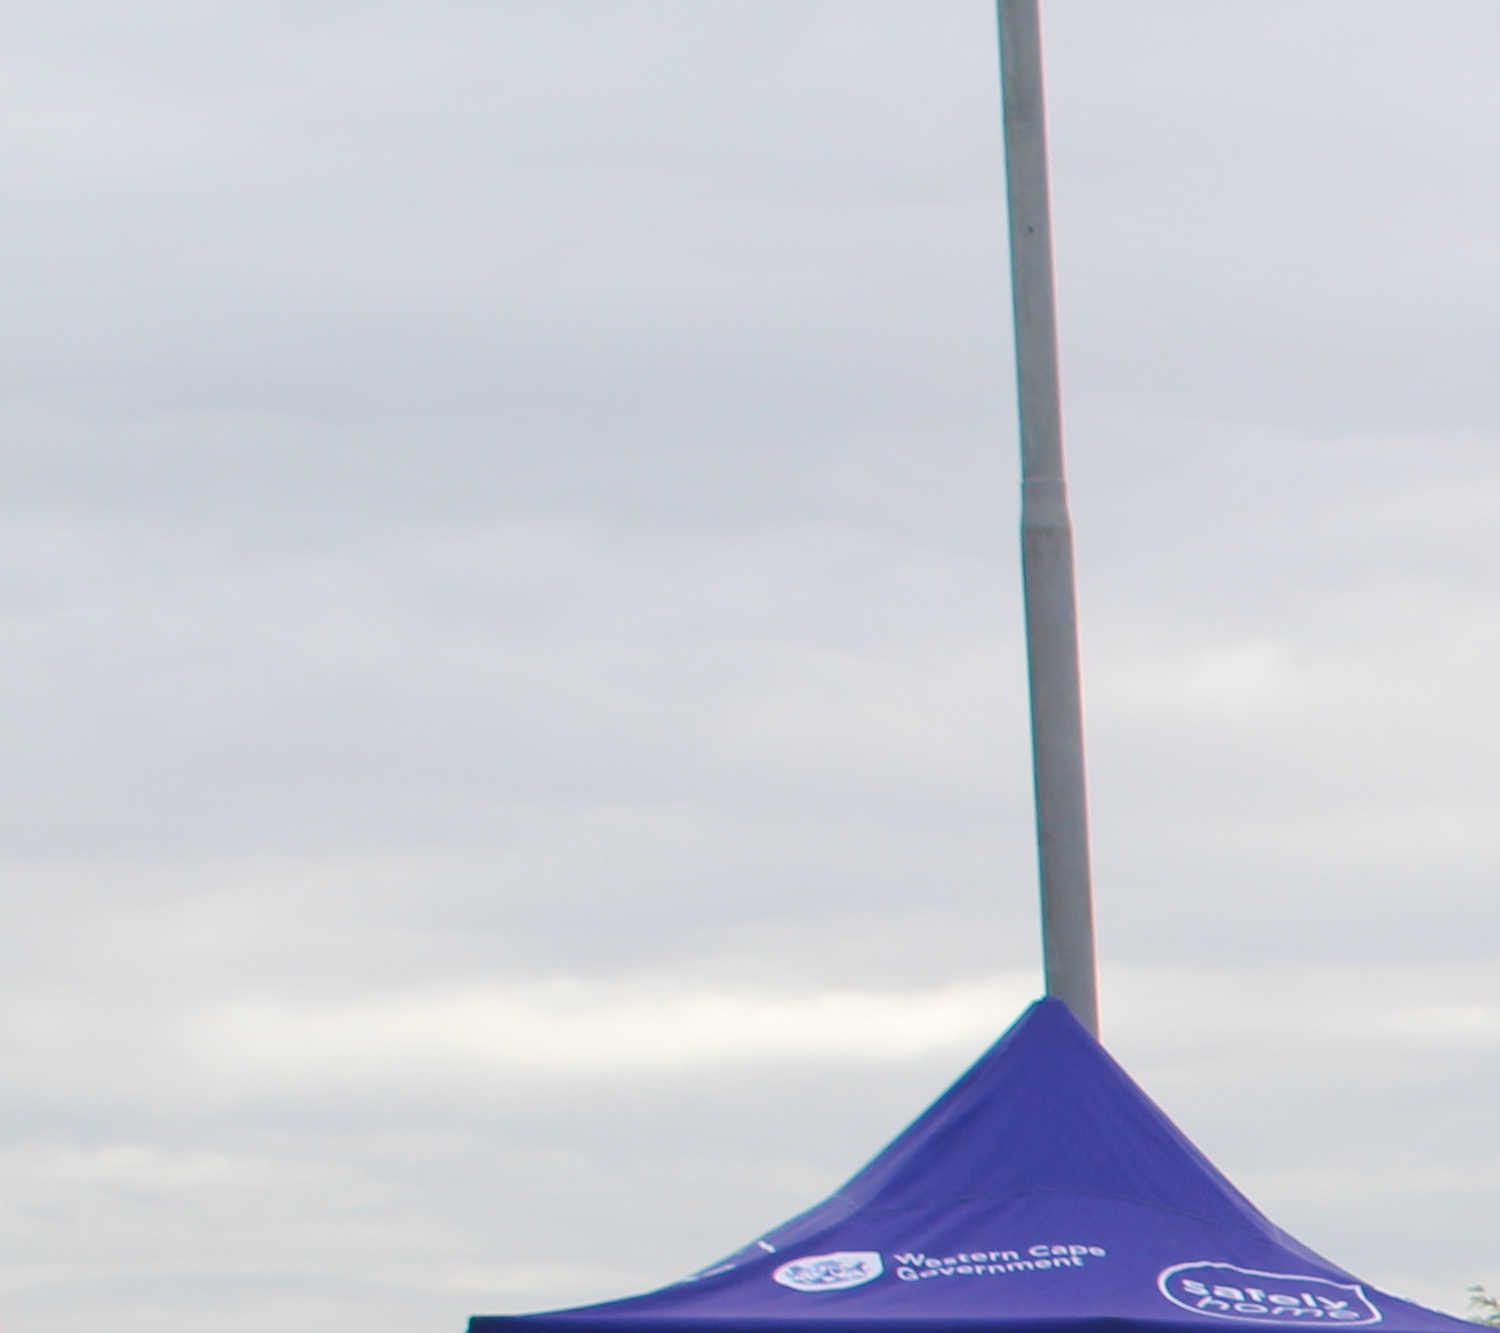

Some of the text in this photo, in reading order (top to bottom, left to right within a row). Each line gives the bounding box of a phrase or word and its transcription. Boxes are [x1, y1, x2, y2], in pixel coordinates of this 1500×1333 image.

[894, 1243, 1106, 1269] Western Cape
[894, 1254, 1084, 1283] Government
